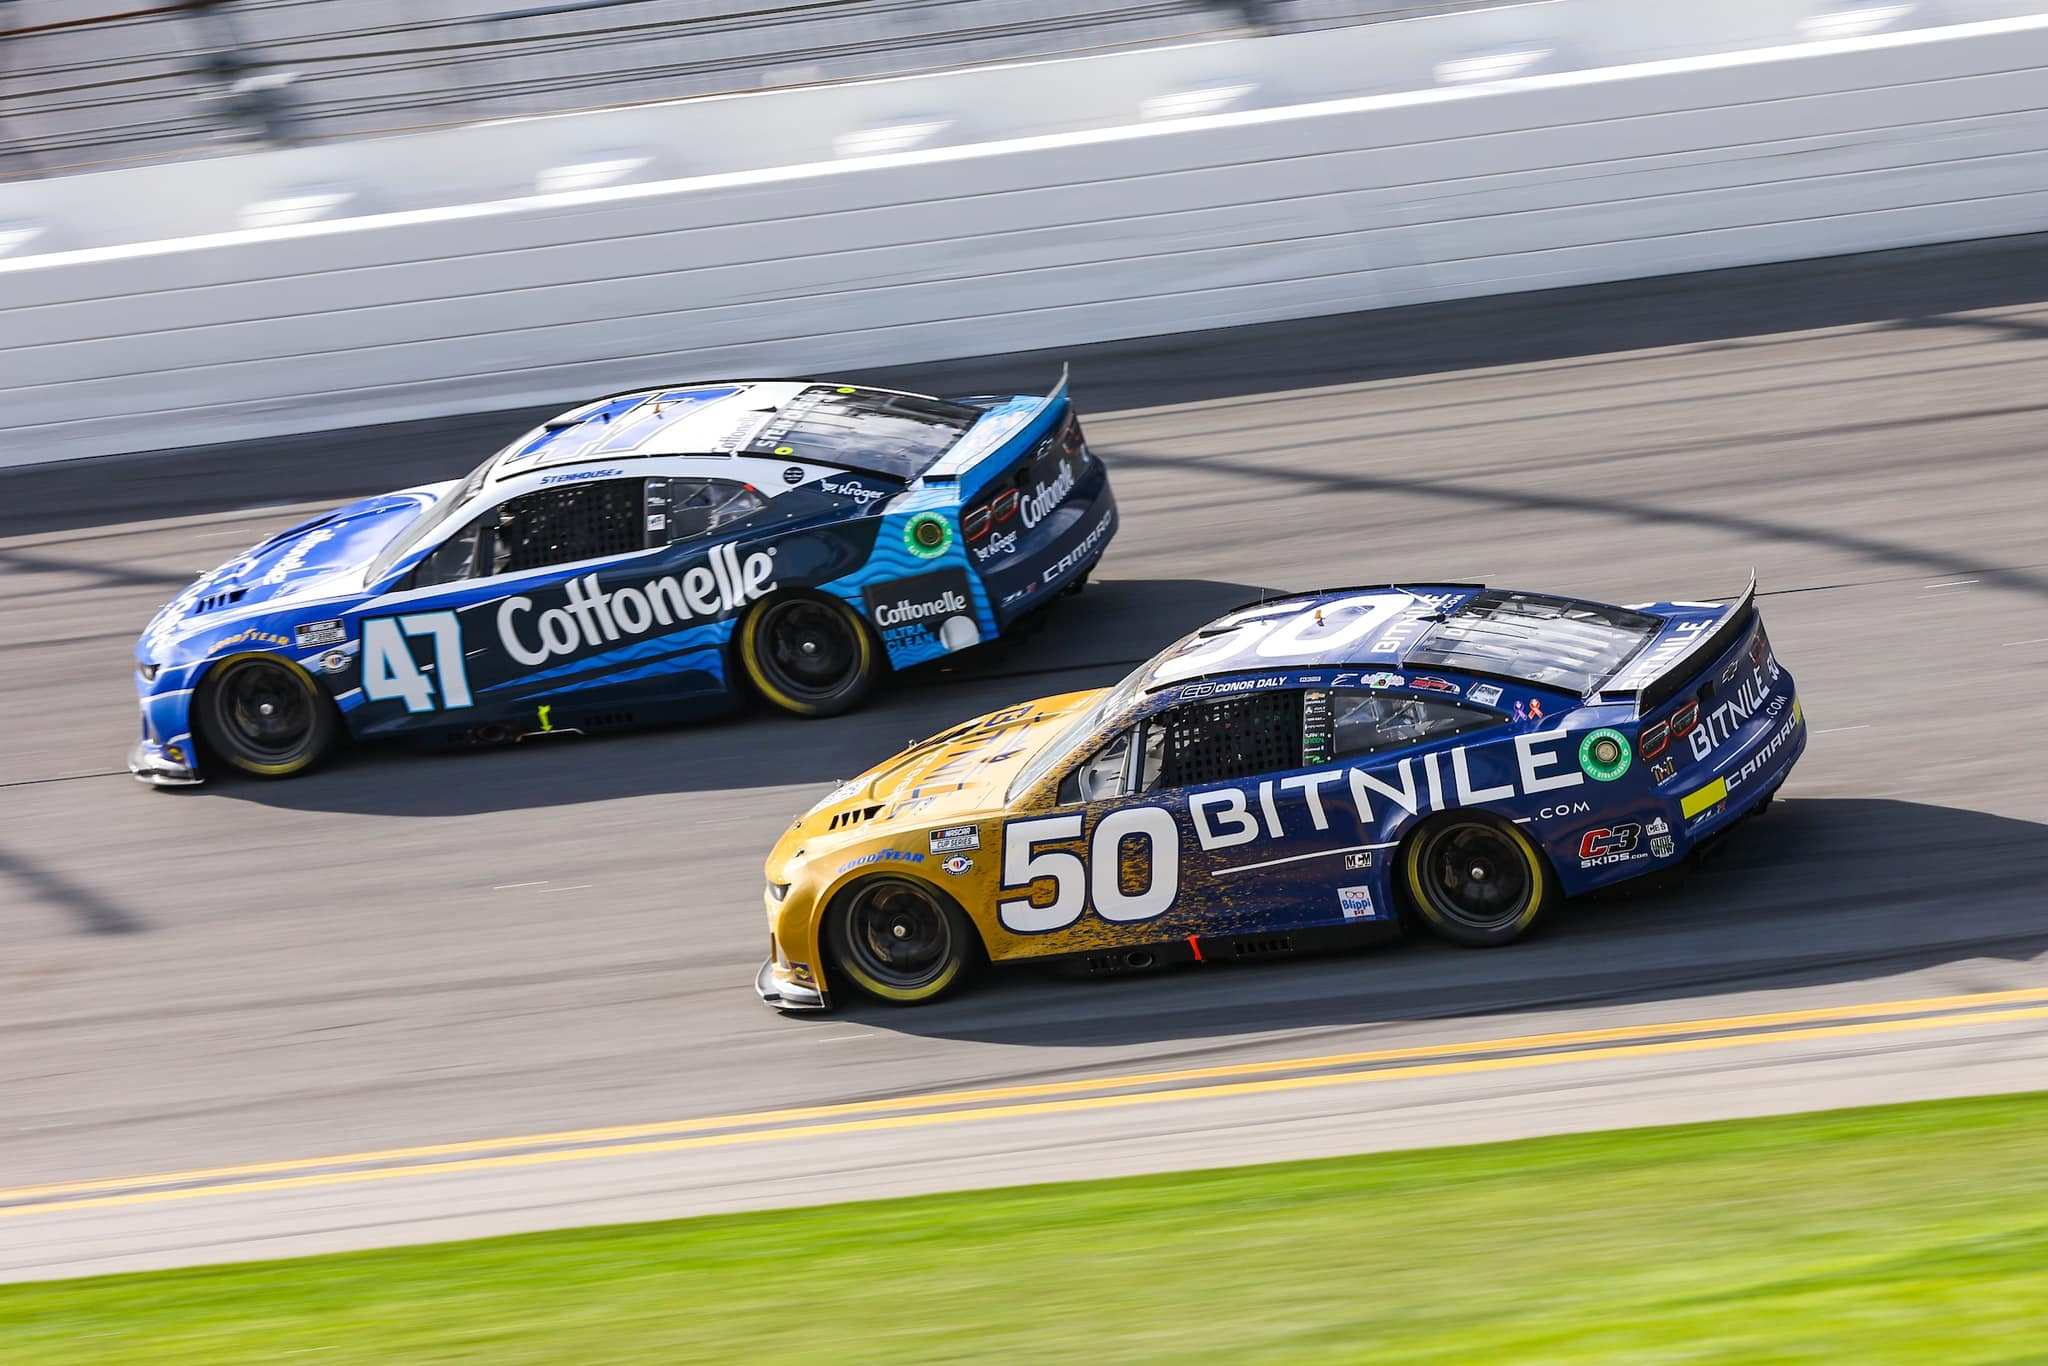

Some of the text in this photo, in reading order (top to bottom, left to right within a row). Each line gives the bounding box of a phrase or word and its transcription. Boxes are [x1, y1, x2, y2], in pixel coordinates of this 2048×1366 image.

[541, 469, 615, 485] STENHOUSE
[838, 481, 885, 504] Kroger
[1020, 457, 1075, 528] Cottonelle
[1042, 510, 1113, 583] CAMARO
[497, 543, 772, 665] Cottonelle
[874, 590, 967, 627] Cottonelle
[882, 623, 928, 642] ULTRA
[886, 632, 935, 652] CLEAN
[363, 611, 472, 711] 47
[1214, 680, 1254, 693] CONOR
[1256, 676, 1288, 690] DALY
[1688, 665, 1770, 762] BITNILE
[1726, 711, 1798, 792] CAMARO
[1189, 729, 1585, 853] BITNILE
[1535, 800, 1591, 820] .COM
[1579, 823, 1642, 860] C3
[837, 847, 925, 874] GOODYEAR
[1000, 806, 1180, 933] 50
[1345, 853, 1372, 870] MCM
[1342, 898, 1371, 910] Blippi
